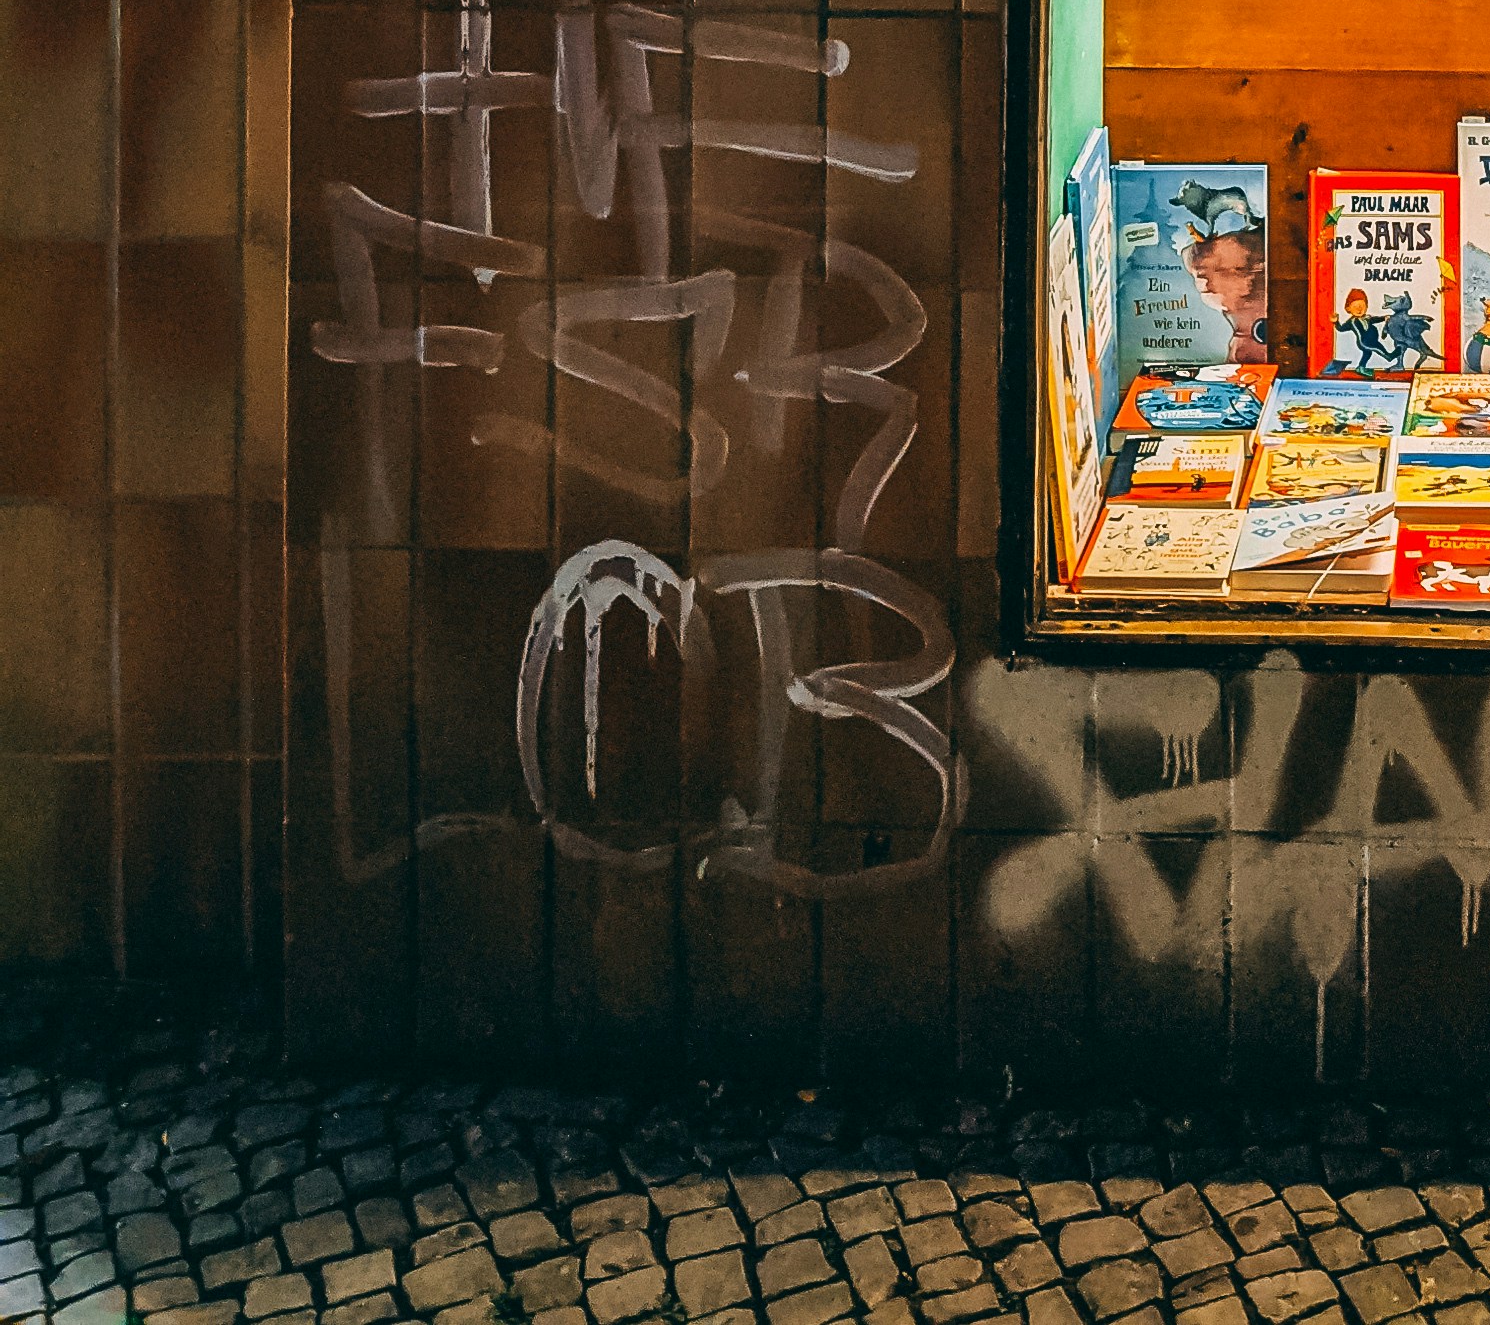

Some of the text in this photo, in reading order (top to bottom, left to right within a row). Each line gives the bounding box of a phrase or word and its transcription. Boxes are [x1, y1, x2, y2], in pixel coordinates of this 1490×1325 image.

[1350, 195, 1430, 213] PAUL MAAR
[1326, 221, 1433, 252] DAS SAMS
[1354, 252, 1422, 267] und der blaue
[1364, 268, 1414, 282] DRACHE
[1148, 276, 1171, 292] Ein
[1134, 295, 1188, 316] Freund
[1153, 316, 1201, 331] wie kein
[1142, 334, 1192, 349] anderer
